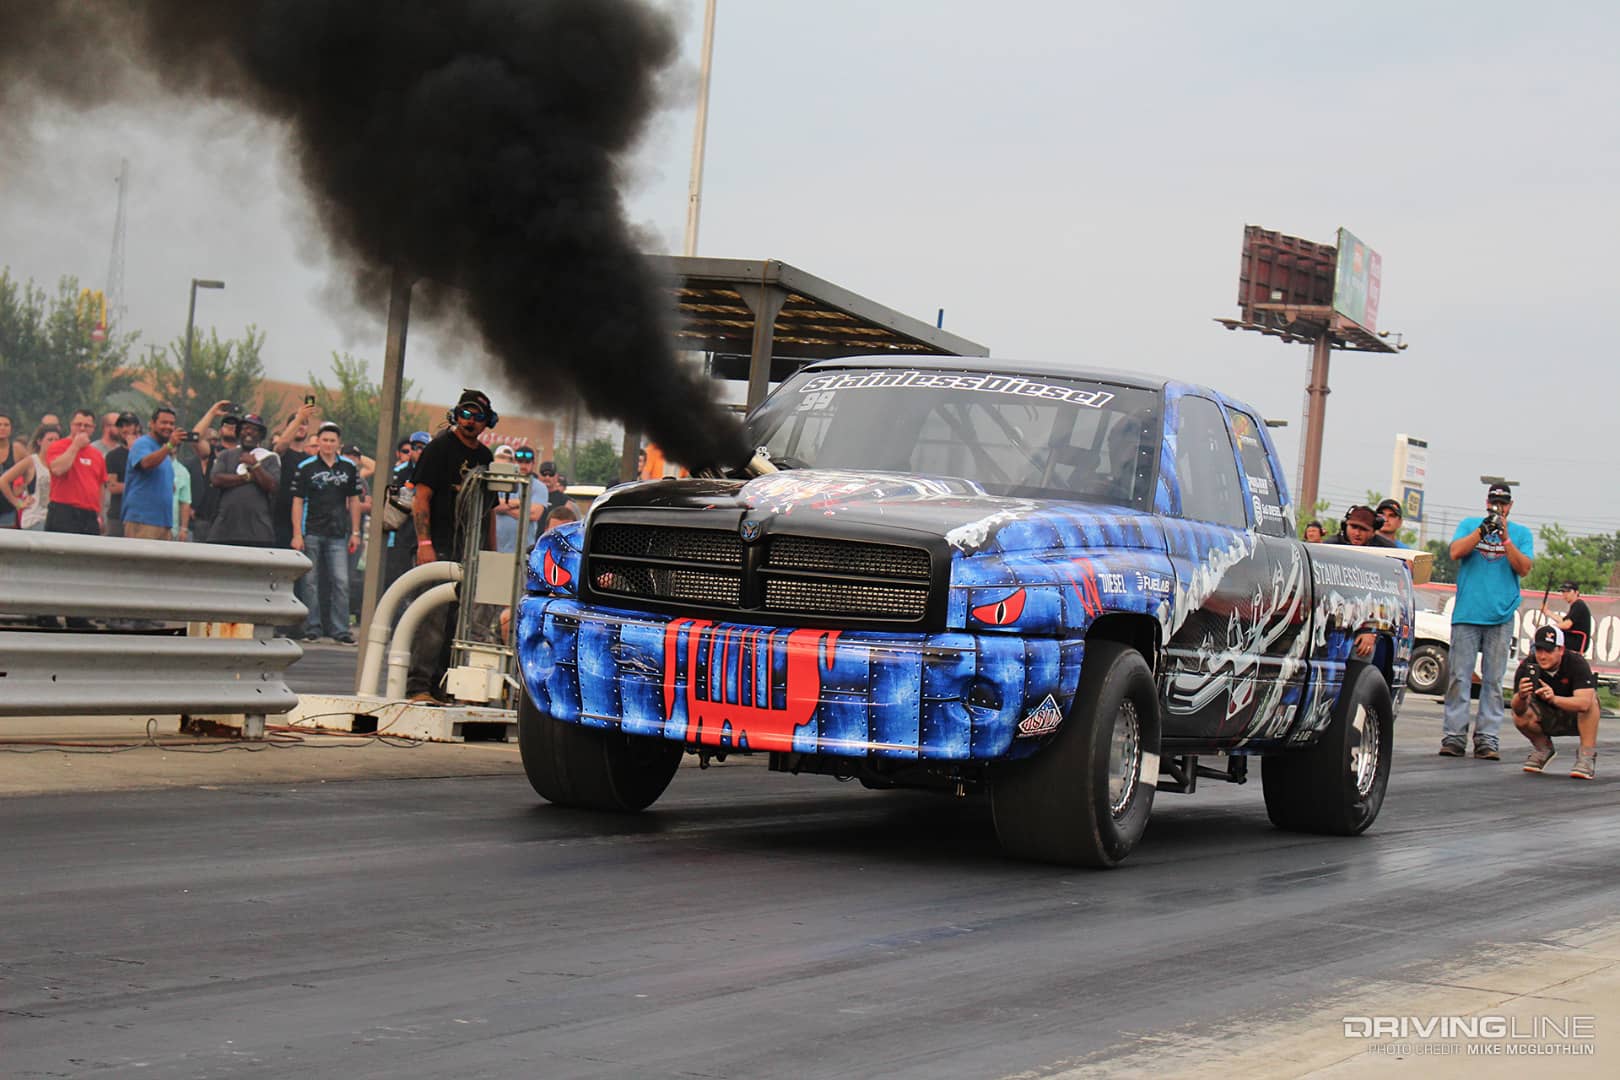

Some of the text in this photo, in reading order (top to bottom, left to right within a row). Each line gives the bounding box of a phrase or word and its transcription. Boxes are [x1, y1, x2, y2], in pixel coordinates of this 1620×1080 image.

[799, 371, 1115, 408] StainlessDiesel
[799, 391, 835, 411] 99
[1098, 573, 1127, 593] DIESEL
